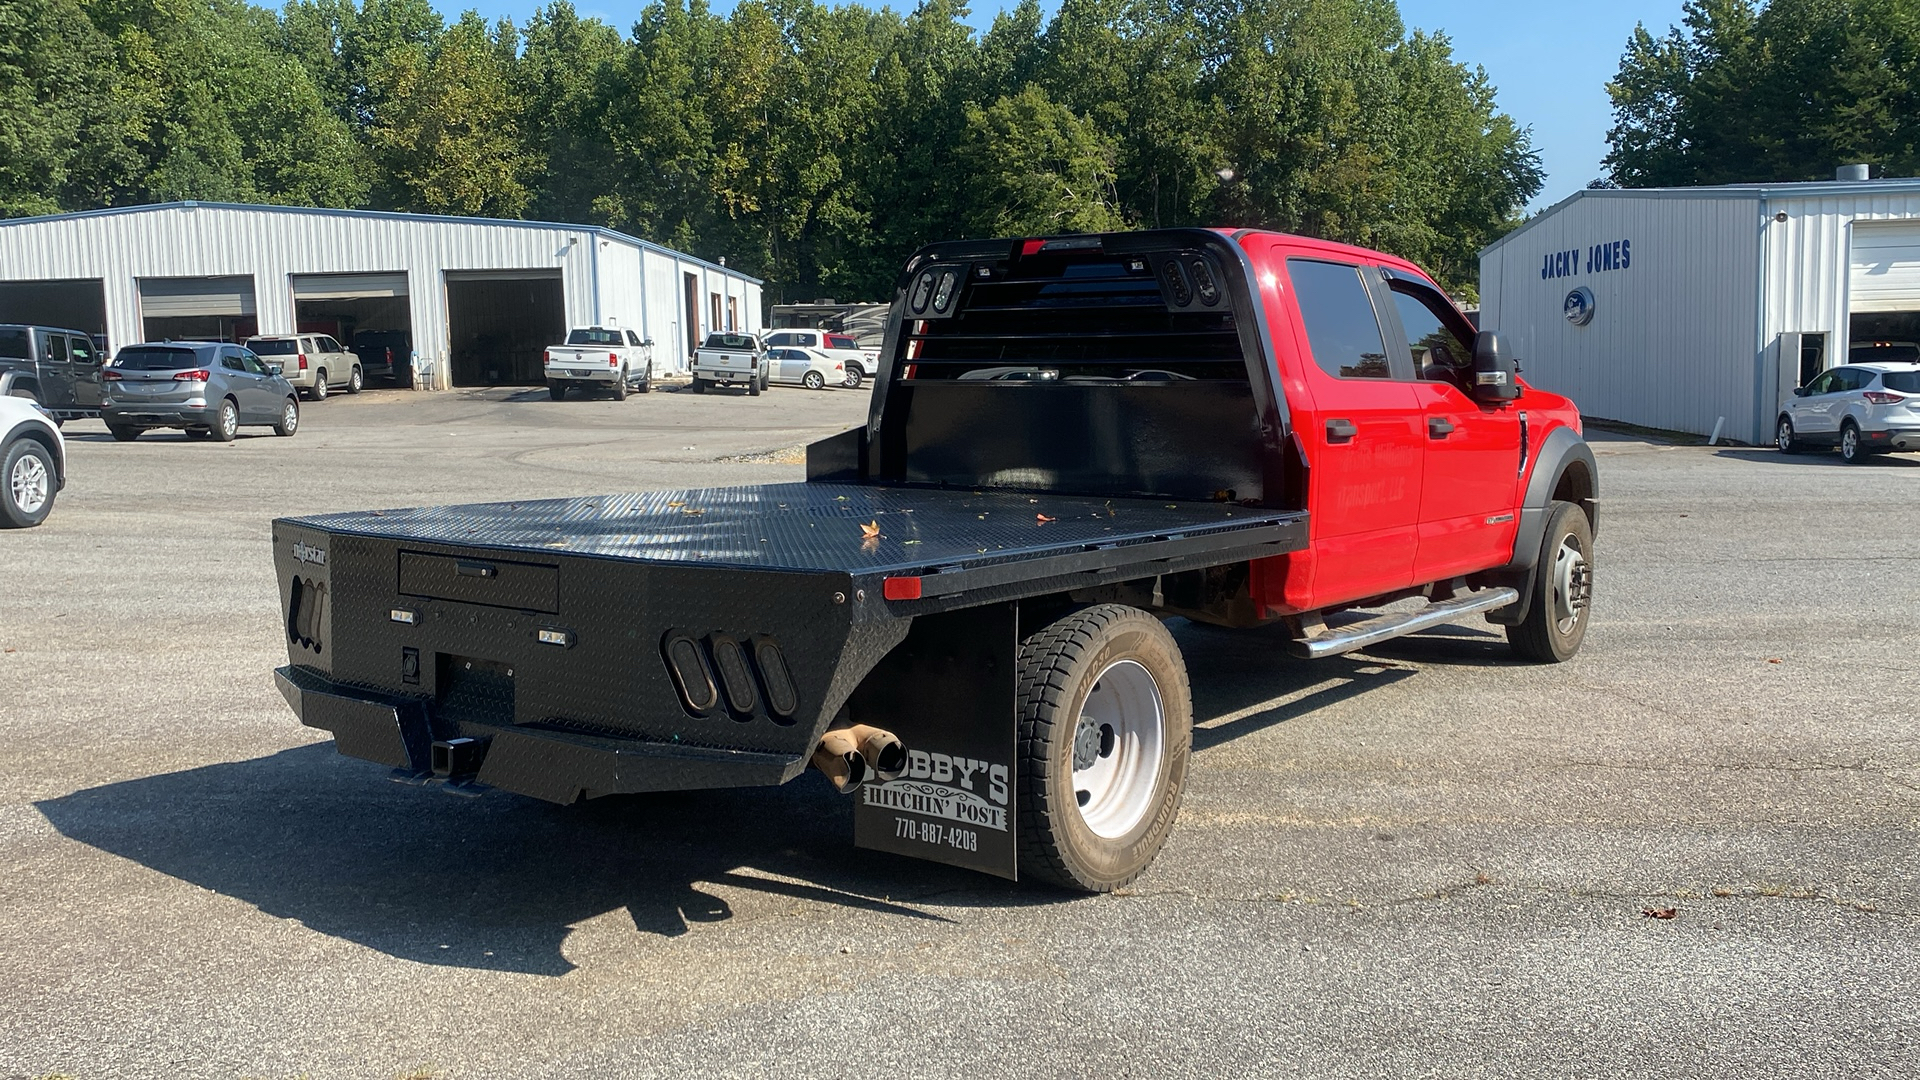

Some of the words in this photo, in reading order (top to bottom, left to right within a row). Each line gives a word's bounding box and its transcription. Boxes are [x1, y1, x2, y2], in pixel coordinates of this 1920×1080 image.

[1541, 249, 1579, 280] JACKY
[1586, 239, 1630, 274] JONES
[863, 749, 1009, 806] BBY'S
[869, 786, 950, 815] HITCHIN'
[955, 802, 1000, 826] POST
[895, 817, 978, 852] 770-887-4203
